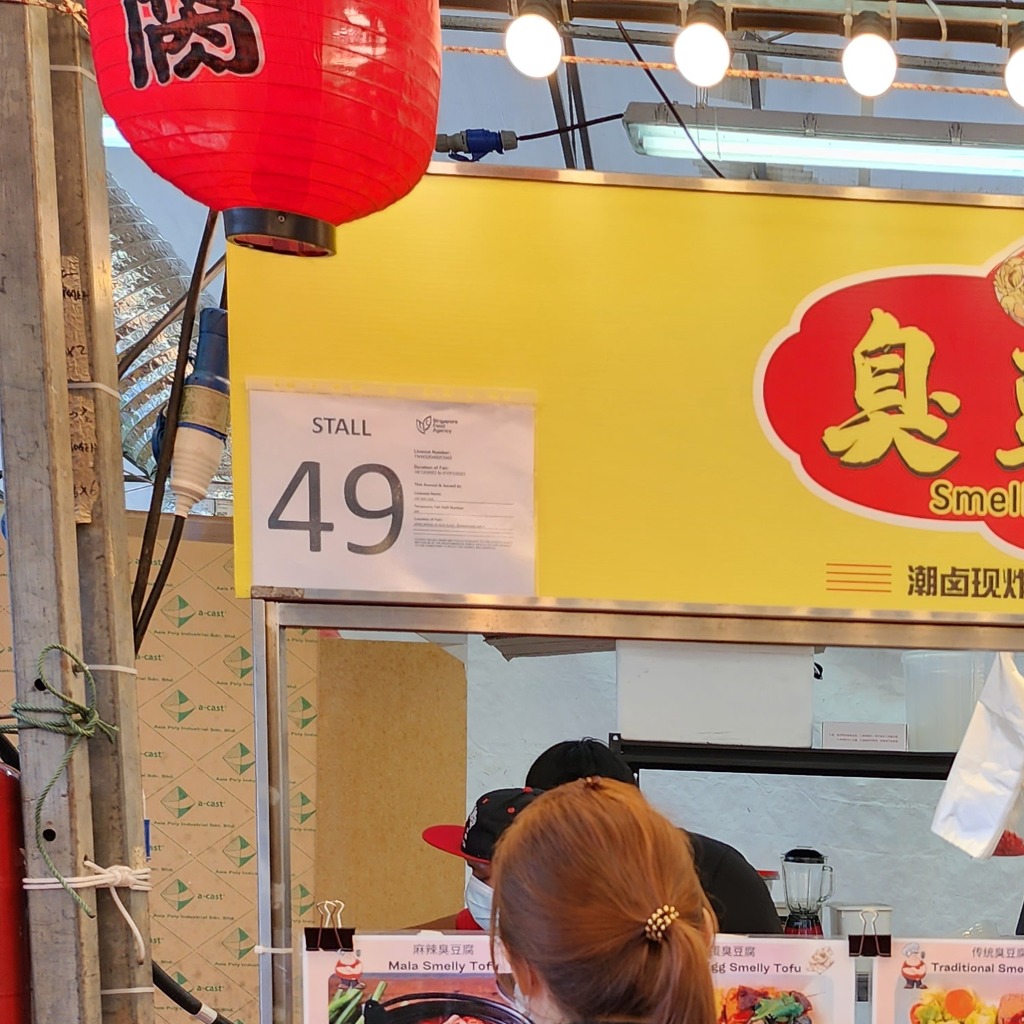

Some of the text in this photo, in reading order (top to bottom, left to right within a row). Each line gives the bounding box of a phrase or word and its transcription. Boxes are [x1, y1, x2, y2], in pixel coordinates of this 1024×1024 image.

[312, 417, 372, 436] STALL
[268, 461, 404, 555] 49
[413, 944, 474, 955] 麻辣臭豆腐
[388, 961, 419, 971] Mala
[423, 960, 466, 973] Smelly
[729, 963, 770, 974] Smelly
[774, 963, 802, 973] Tofu
[931, 962, 995, 973] Traditional
